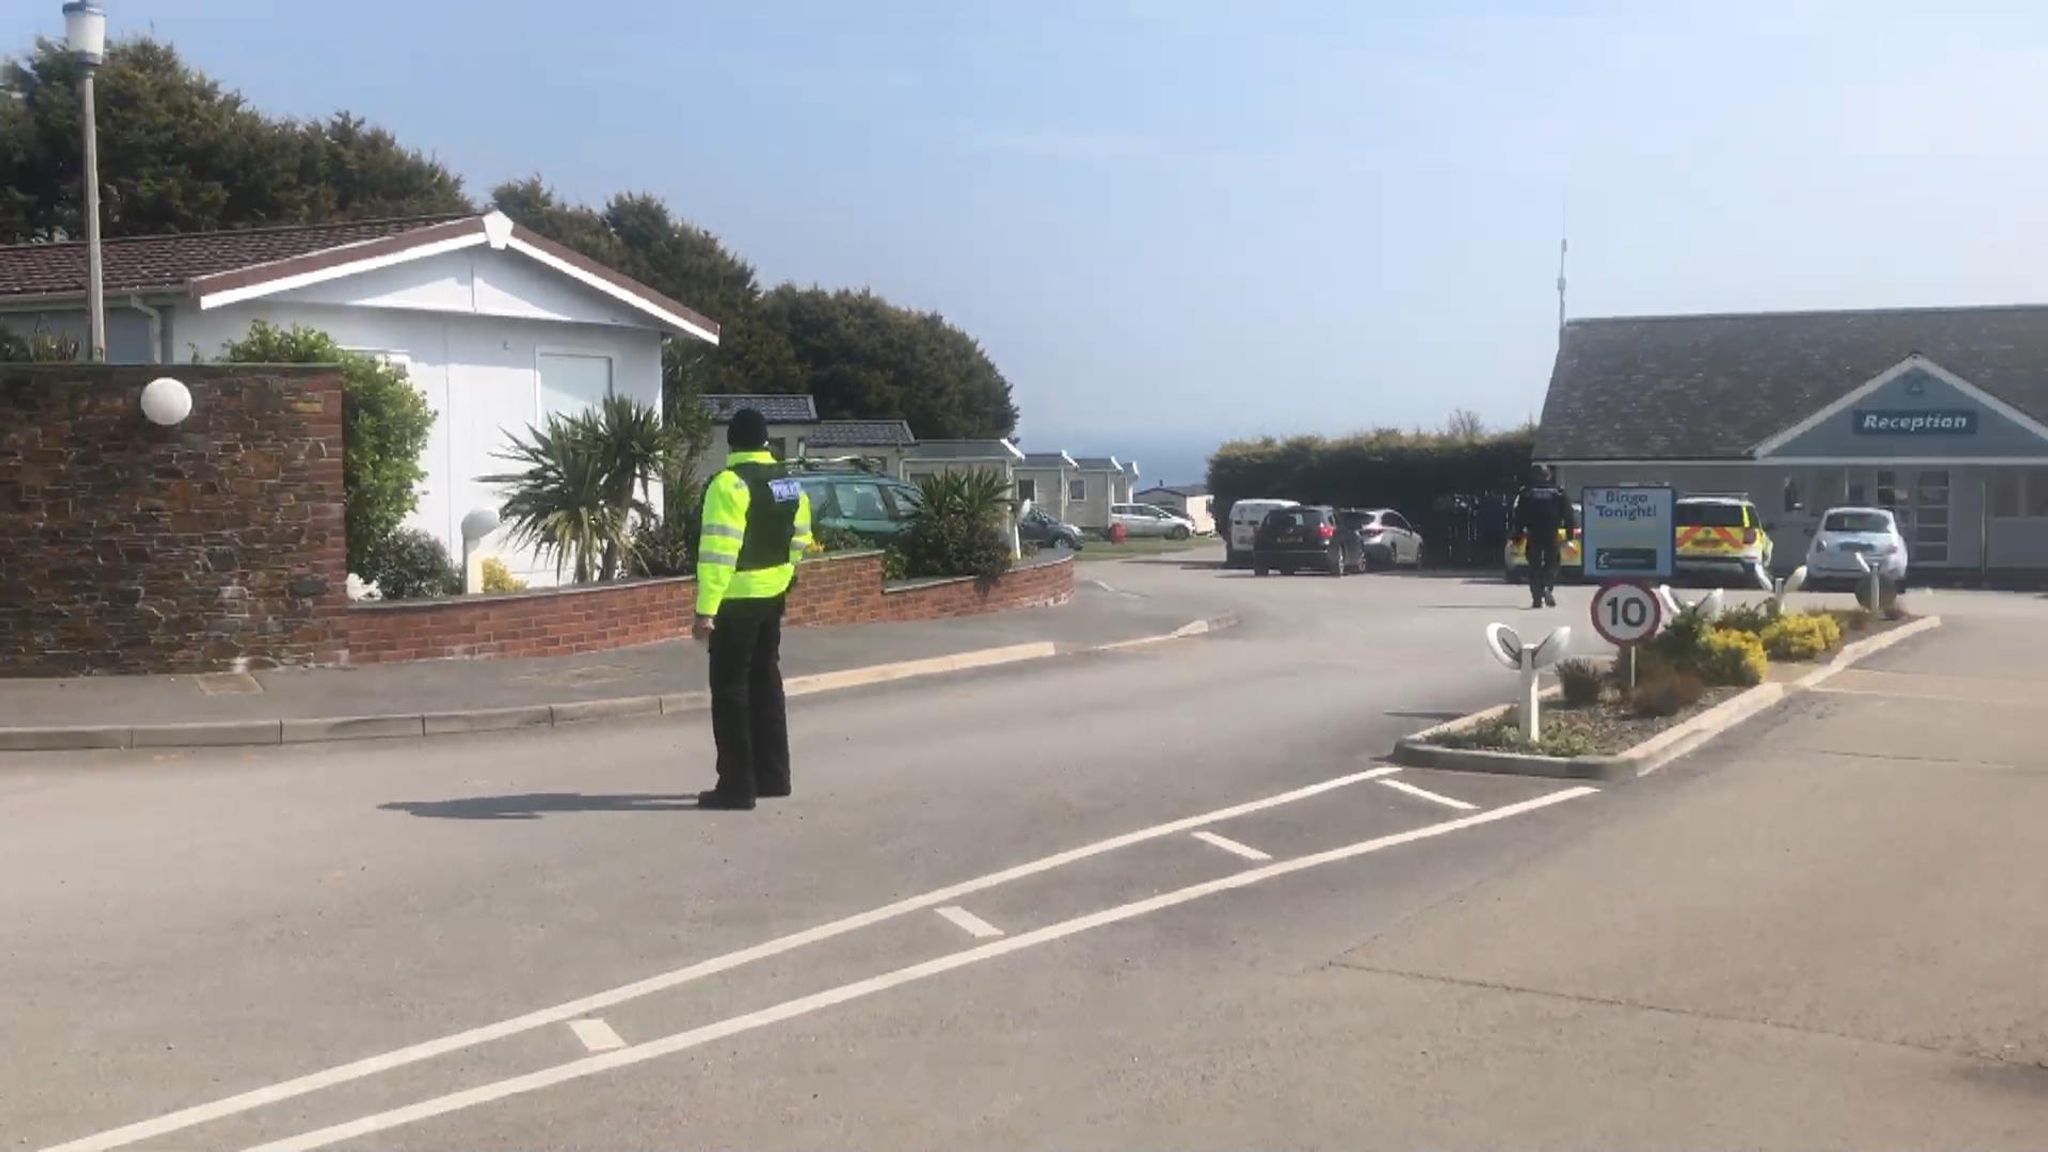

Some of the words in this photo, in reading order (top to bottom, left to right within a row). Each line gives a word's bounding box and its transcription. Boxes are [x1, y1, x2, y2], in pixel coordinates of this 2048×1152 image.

[1863, 413, 1967, 432] Reception
[1606, 490, 1648, 506] Bingo
[1595, 504, 1657, 521] Tonight!
[1606, 596, 1647, 628] 10
